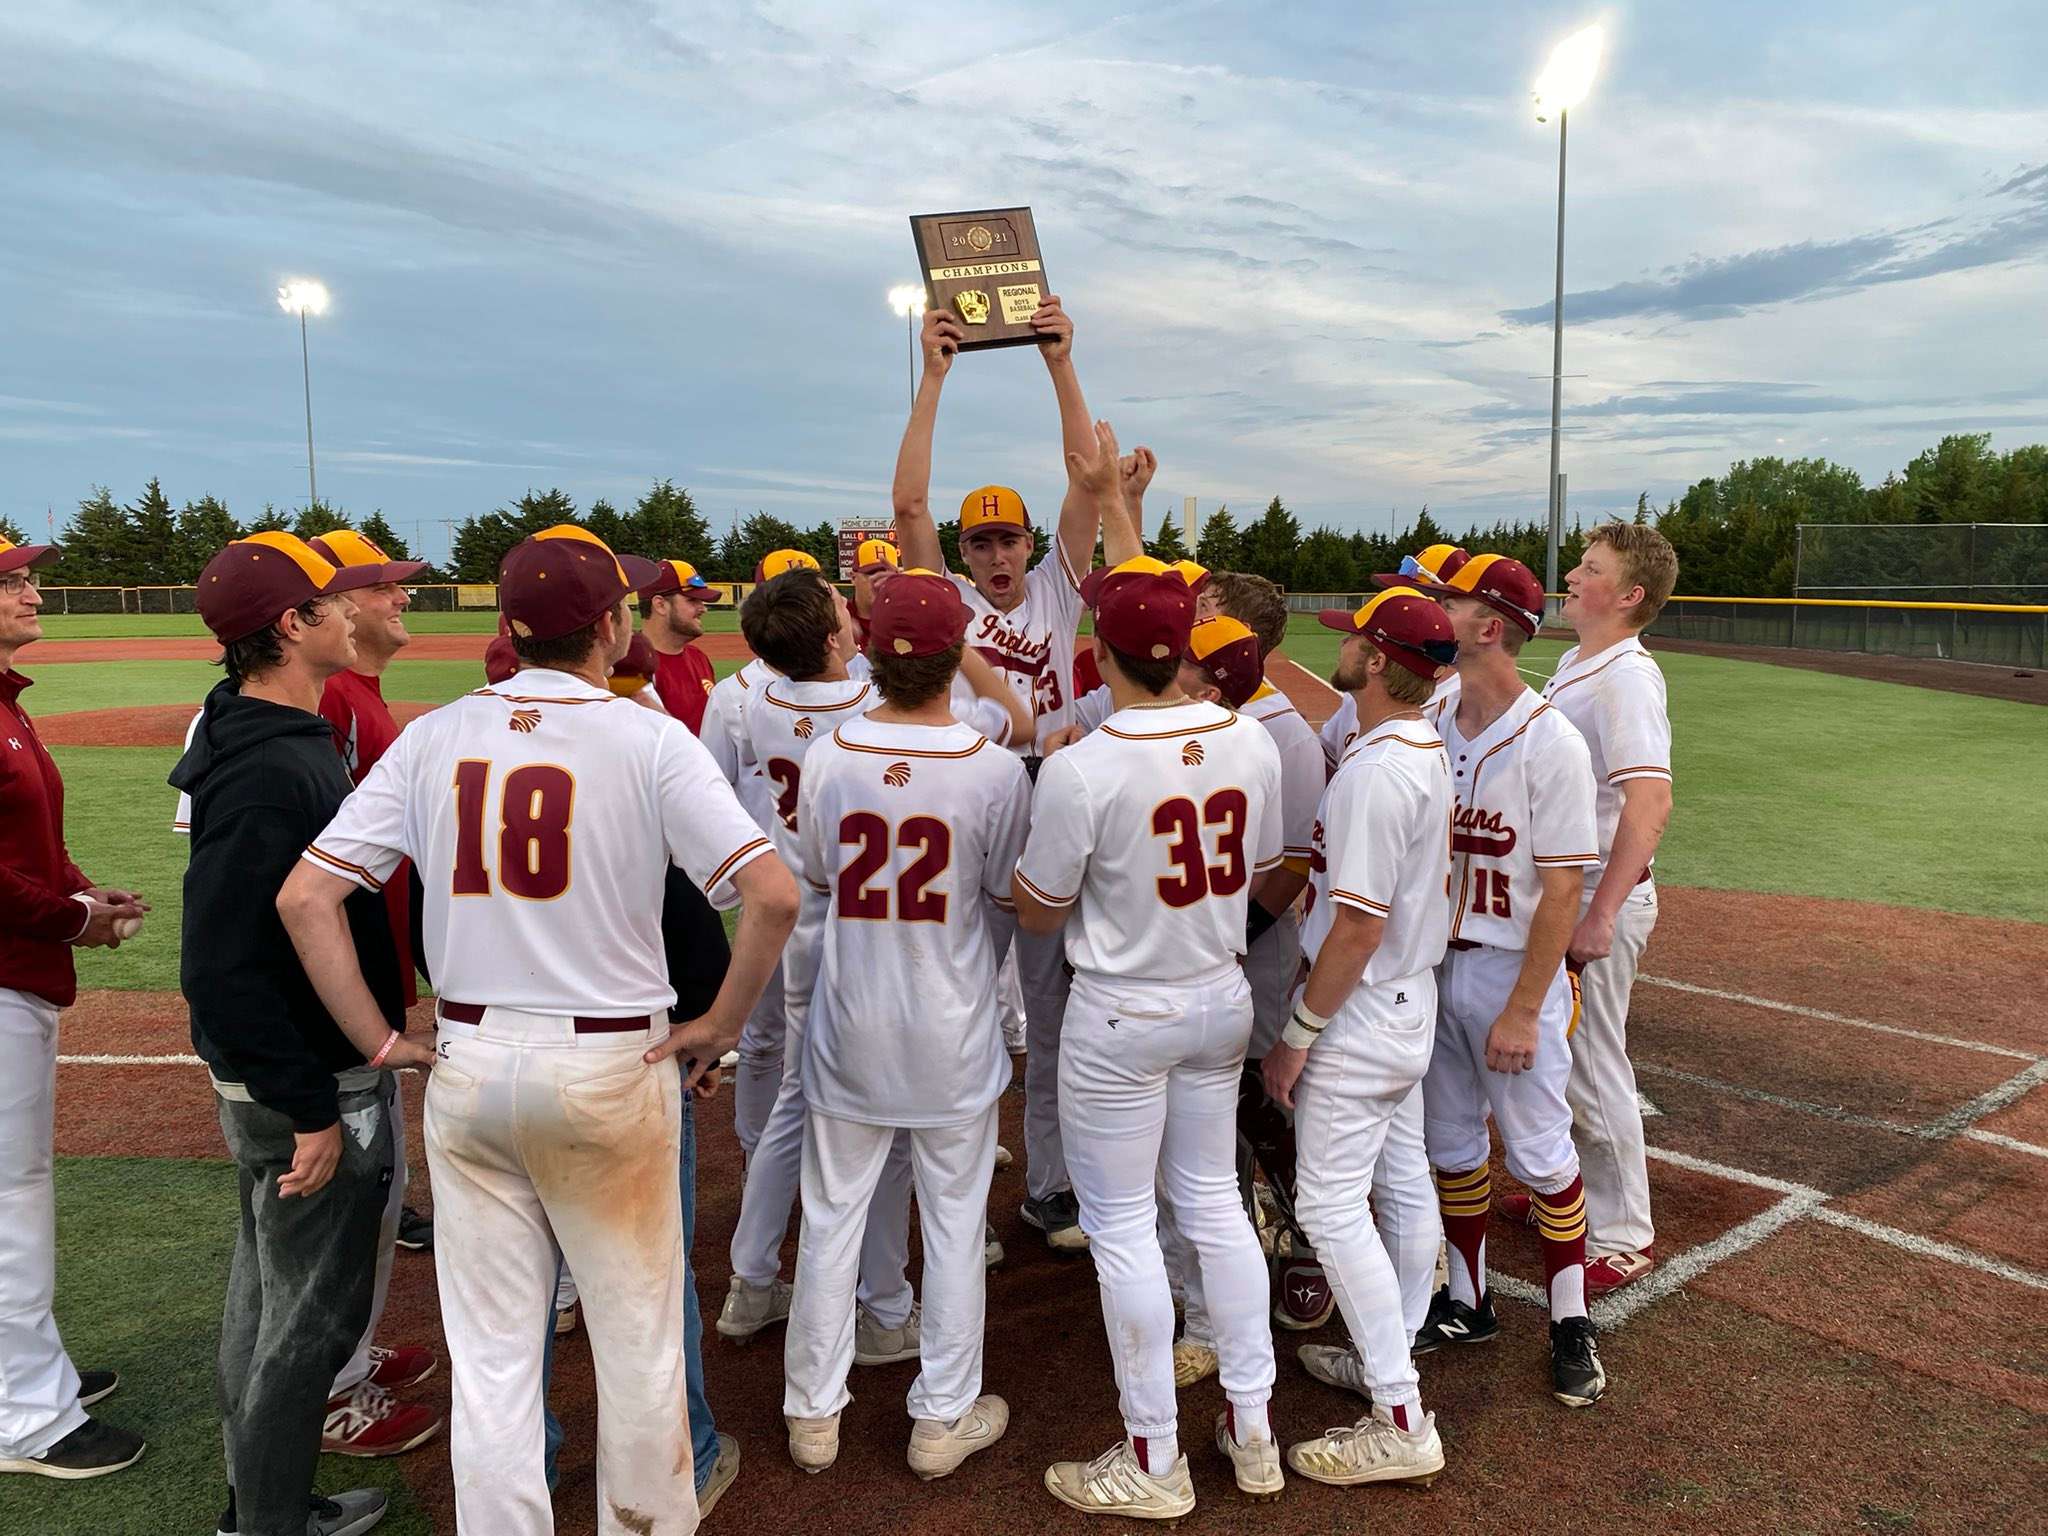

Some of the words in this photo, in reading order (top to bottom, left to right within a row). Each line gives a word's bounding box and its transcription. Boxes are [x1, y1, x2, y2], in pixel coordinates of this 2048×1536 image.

[951, 236, 966, 246] 20
[994, 232, 1007, 242] 21
[943, 262, 1029, 278] CHAMPIONS
[1002, 286, 1037, 297] REGIONAL
[1010, 304, 1037, 312] BASEBALL
[982, 494, 1000, 517] H
[858, 532, 864, 541] 0
[888, 532, 895, 541] 0
[451, 758, 577, 902] 18
[1152, 785, 1248, 910] 33
[837, 809, 952, 926] 22
[1471, 866, 1512, 918] 15
